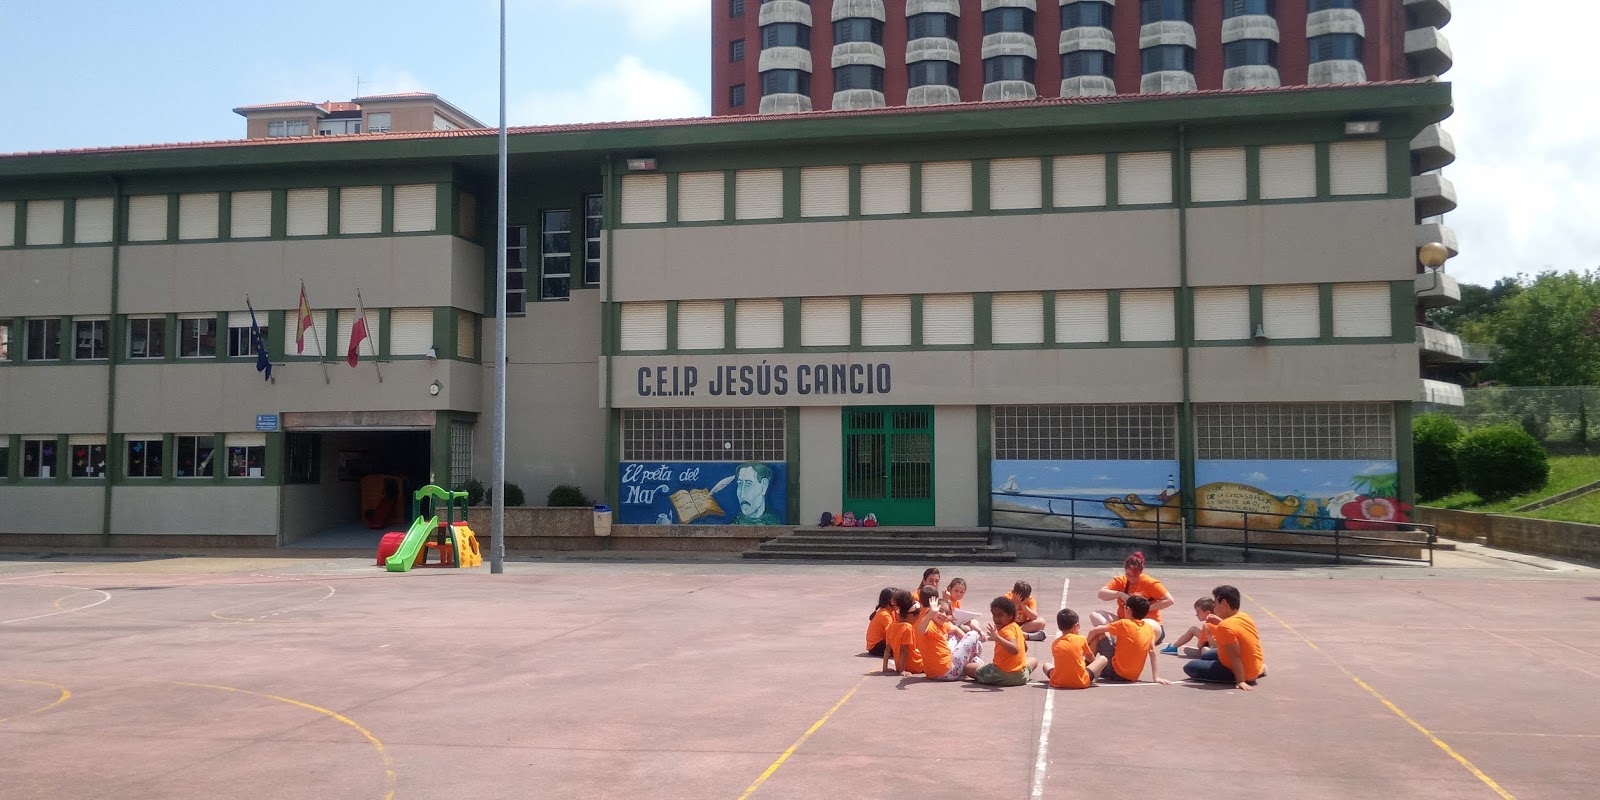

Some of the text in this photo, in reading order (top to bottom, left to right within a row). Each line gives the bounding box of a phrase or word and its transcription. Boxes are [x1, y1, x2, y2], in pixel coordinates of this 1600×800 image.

[708, 359, 789, 396] JESÚS
[796, 363, 892, 395] CANCIO
[622, 463, 700, 484] El poeta del
[622, 484, 670, 504] Mar
